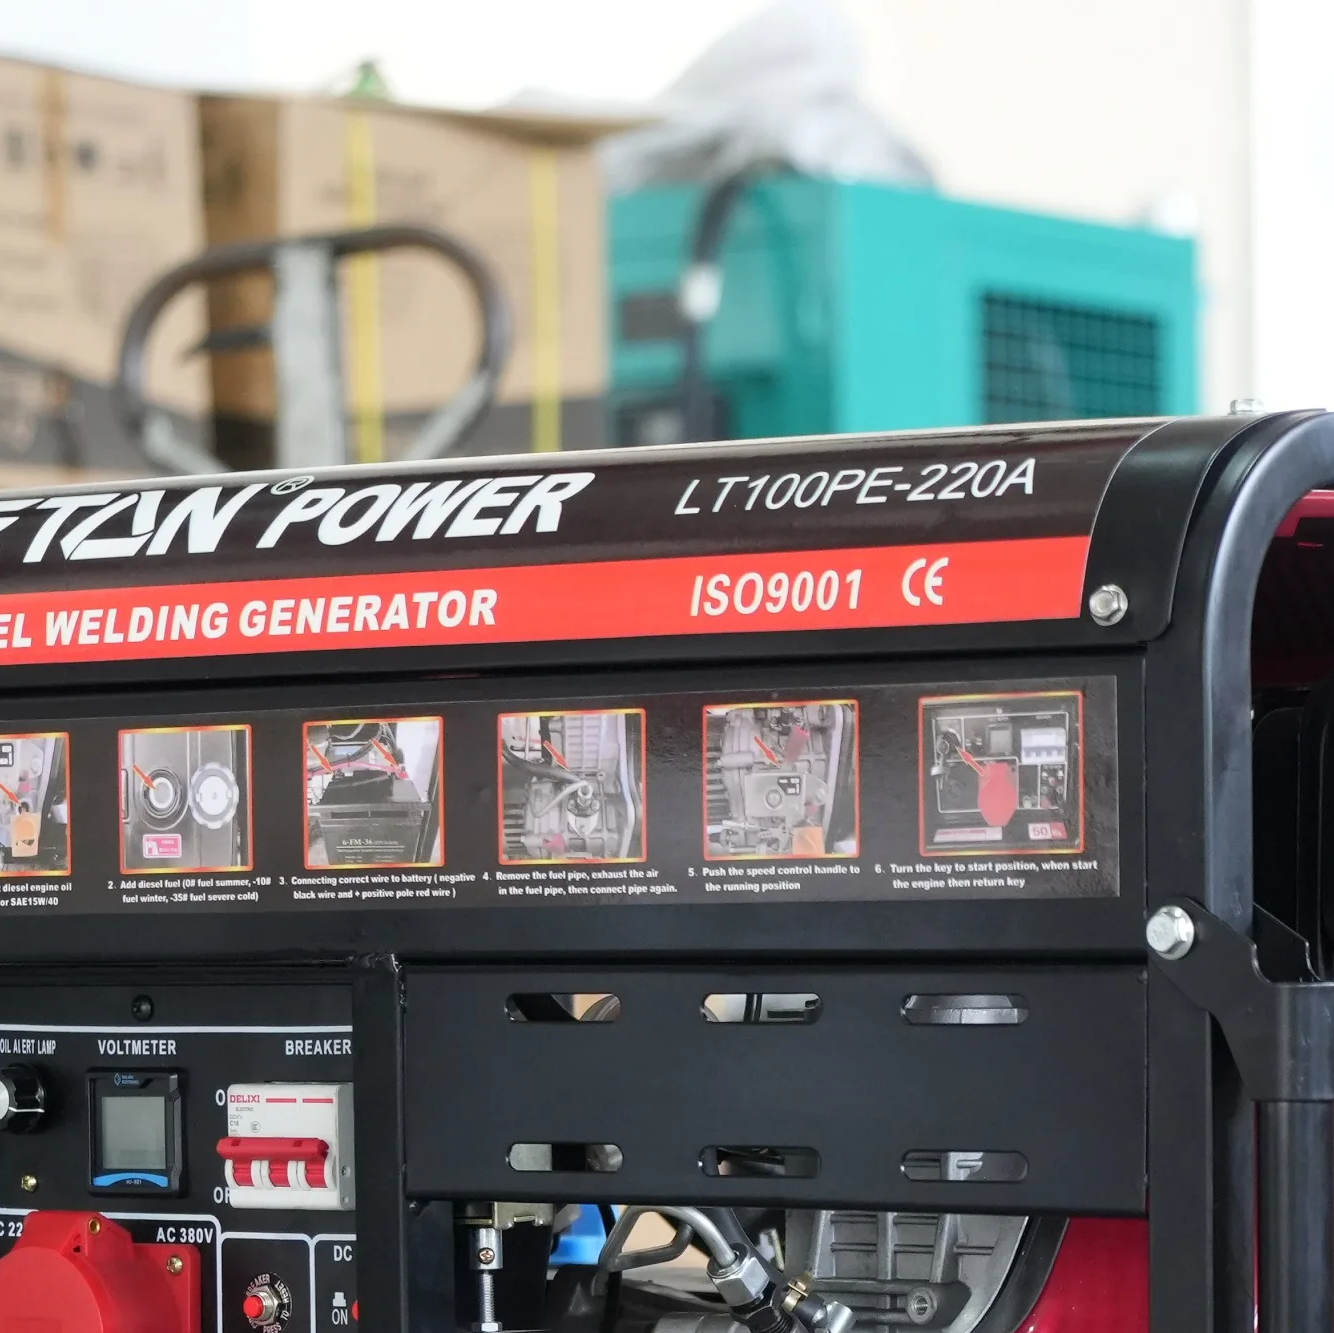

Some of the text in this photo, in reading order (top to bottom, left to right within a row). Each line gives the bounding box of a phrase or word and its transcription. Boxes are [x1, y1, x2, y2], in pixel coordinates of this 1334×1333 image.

[674, 457, 1036, 516] LT100PE-220A
[255, 472, 595, 550] POWER
[689, 557, 950, 617] ISO9001 CE
[44, 602, 229, 647] WELDING
[238, 588, 499, 637] GENERATOR
[703, 865, 860, 878] Push the speed control handle to
[890, 860, 1098, 875] Turn the key to start position, when start
[291, 873, 475, 887] Connecting correct wire to battery negative
[496, 869, 659, 881] Remove the fuel pipe, exhaust the air
[3, 883, 29, 892] diesel
[30, 884, 59, 893] engine
[61, 883, 72, 891] oil
[120, 880, 136, 889] Add
[138, 880, 163, 889] diesel
[165, 879, 180, 888] fuel
[198, 879, 213, 887] fuel
[216, 879, 251, 887] summer,
[498, 883, 678, 896] in the fuel pipe, then connect pipe again.
[705, 881, 800, 893] the running position
[893, 877, 1025, 890] the engine then return key
[123, 895, 138, 903] fuel
[140, 894, 168, 903] winter,
[190, 893, 205, 901] fuel
[237, 892, 258, 901] cold)
[293, 888, 450, 900] black wire and positive pole red wire
[11, 897, 58, 906] SAE15W/40
[0, 1039, 11, 1054] OIL
[38, 1040, 56, 1054] LAMP
[97, 1039, 177, 1056] VOLTMETER
[285, 1040, 351, 1056] BREAKER
[230, 1095, 260, 1103] DELIXI
[156, 1227, 213, 1244] AC 380V
[333, 1245, 353, 1261] DC
[274, 1280, 289, 1303] RESET
[280, 1310, 289, 1320] TO
[332, 1308, 348, 1325] ON
